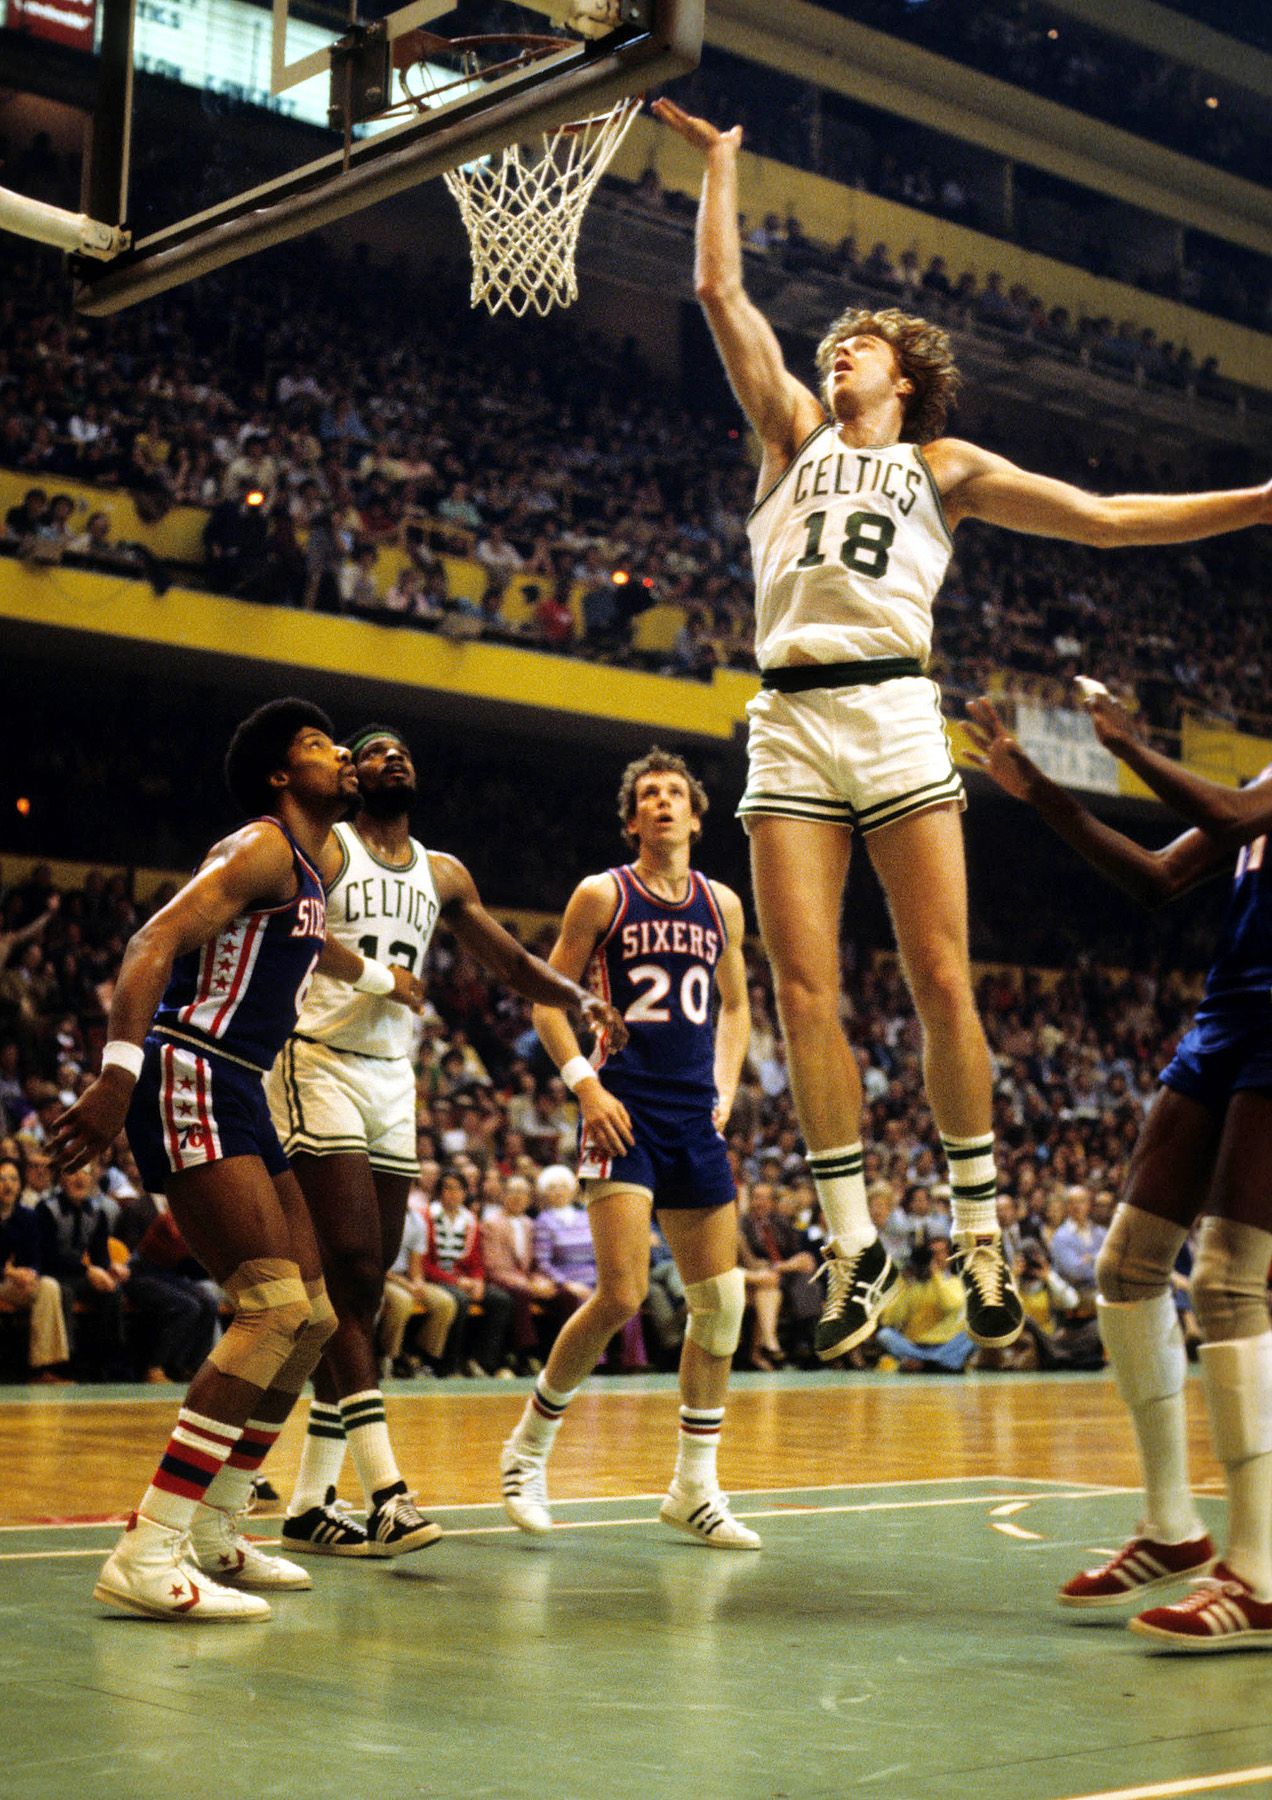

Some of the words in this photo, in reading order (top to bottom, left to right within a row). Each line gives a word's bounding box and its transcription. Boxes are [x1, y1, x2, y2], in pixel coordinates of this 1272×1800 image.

[794, 453, 922, 517] CELTICS
[797, 510, 896, 580] 18
[345, 877, 436, 941] CELTICS
[622, 920, 719, 966] SIXERS
[623, 964, 710, 1026] 20
[175, 1123, 206, 1150] 76
